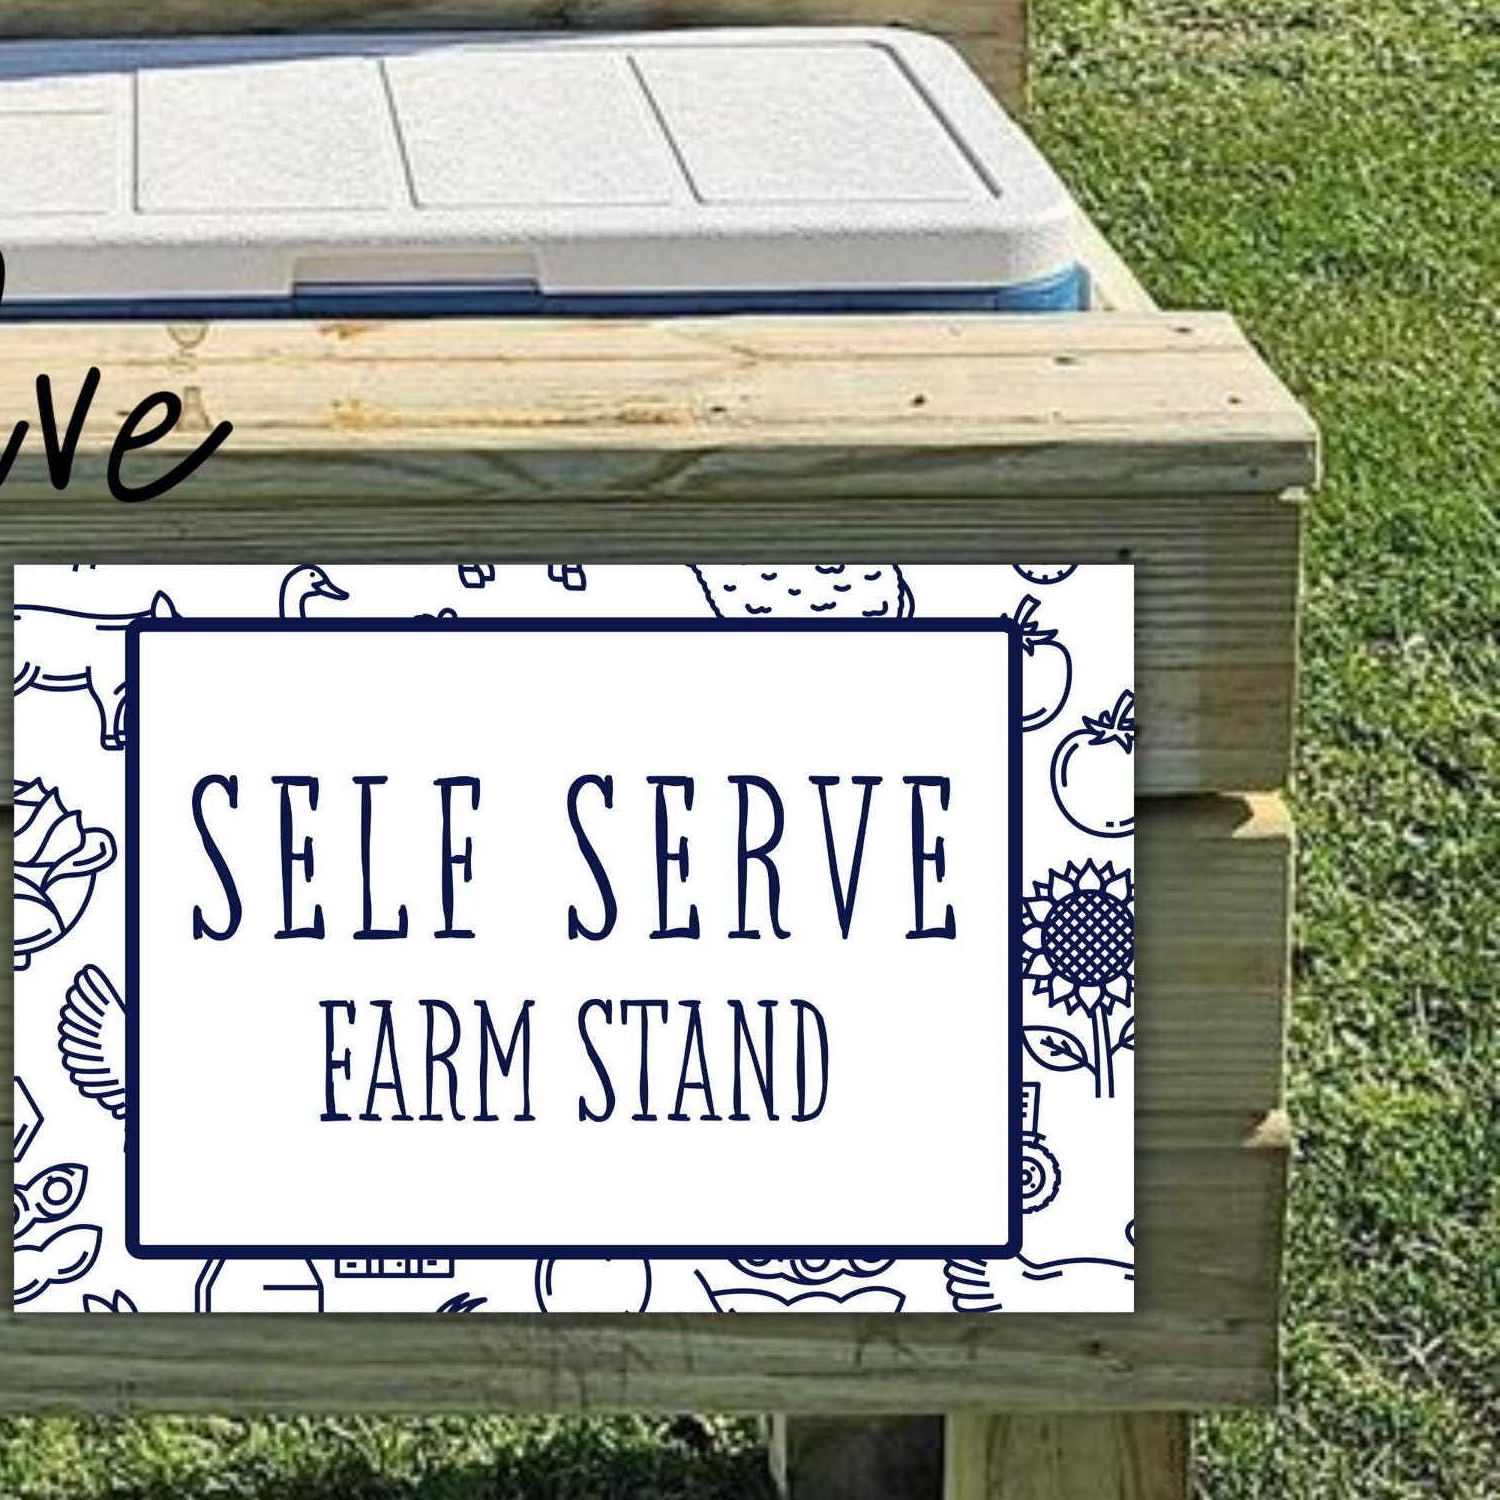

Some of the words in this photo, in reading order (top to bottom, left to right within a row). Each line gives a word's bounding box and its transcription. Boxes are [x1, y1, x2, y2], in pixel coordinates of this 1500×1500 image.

[192, 774, 480, 941] SELF
[567, 775, 956, 941] SERVE
[319, 1000, 535, 1121] FARM
[578, 999, 828, 1122] STAND
